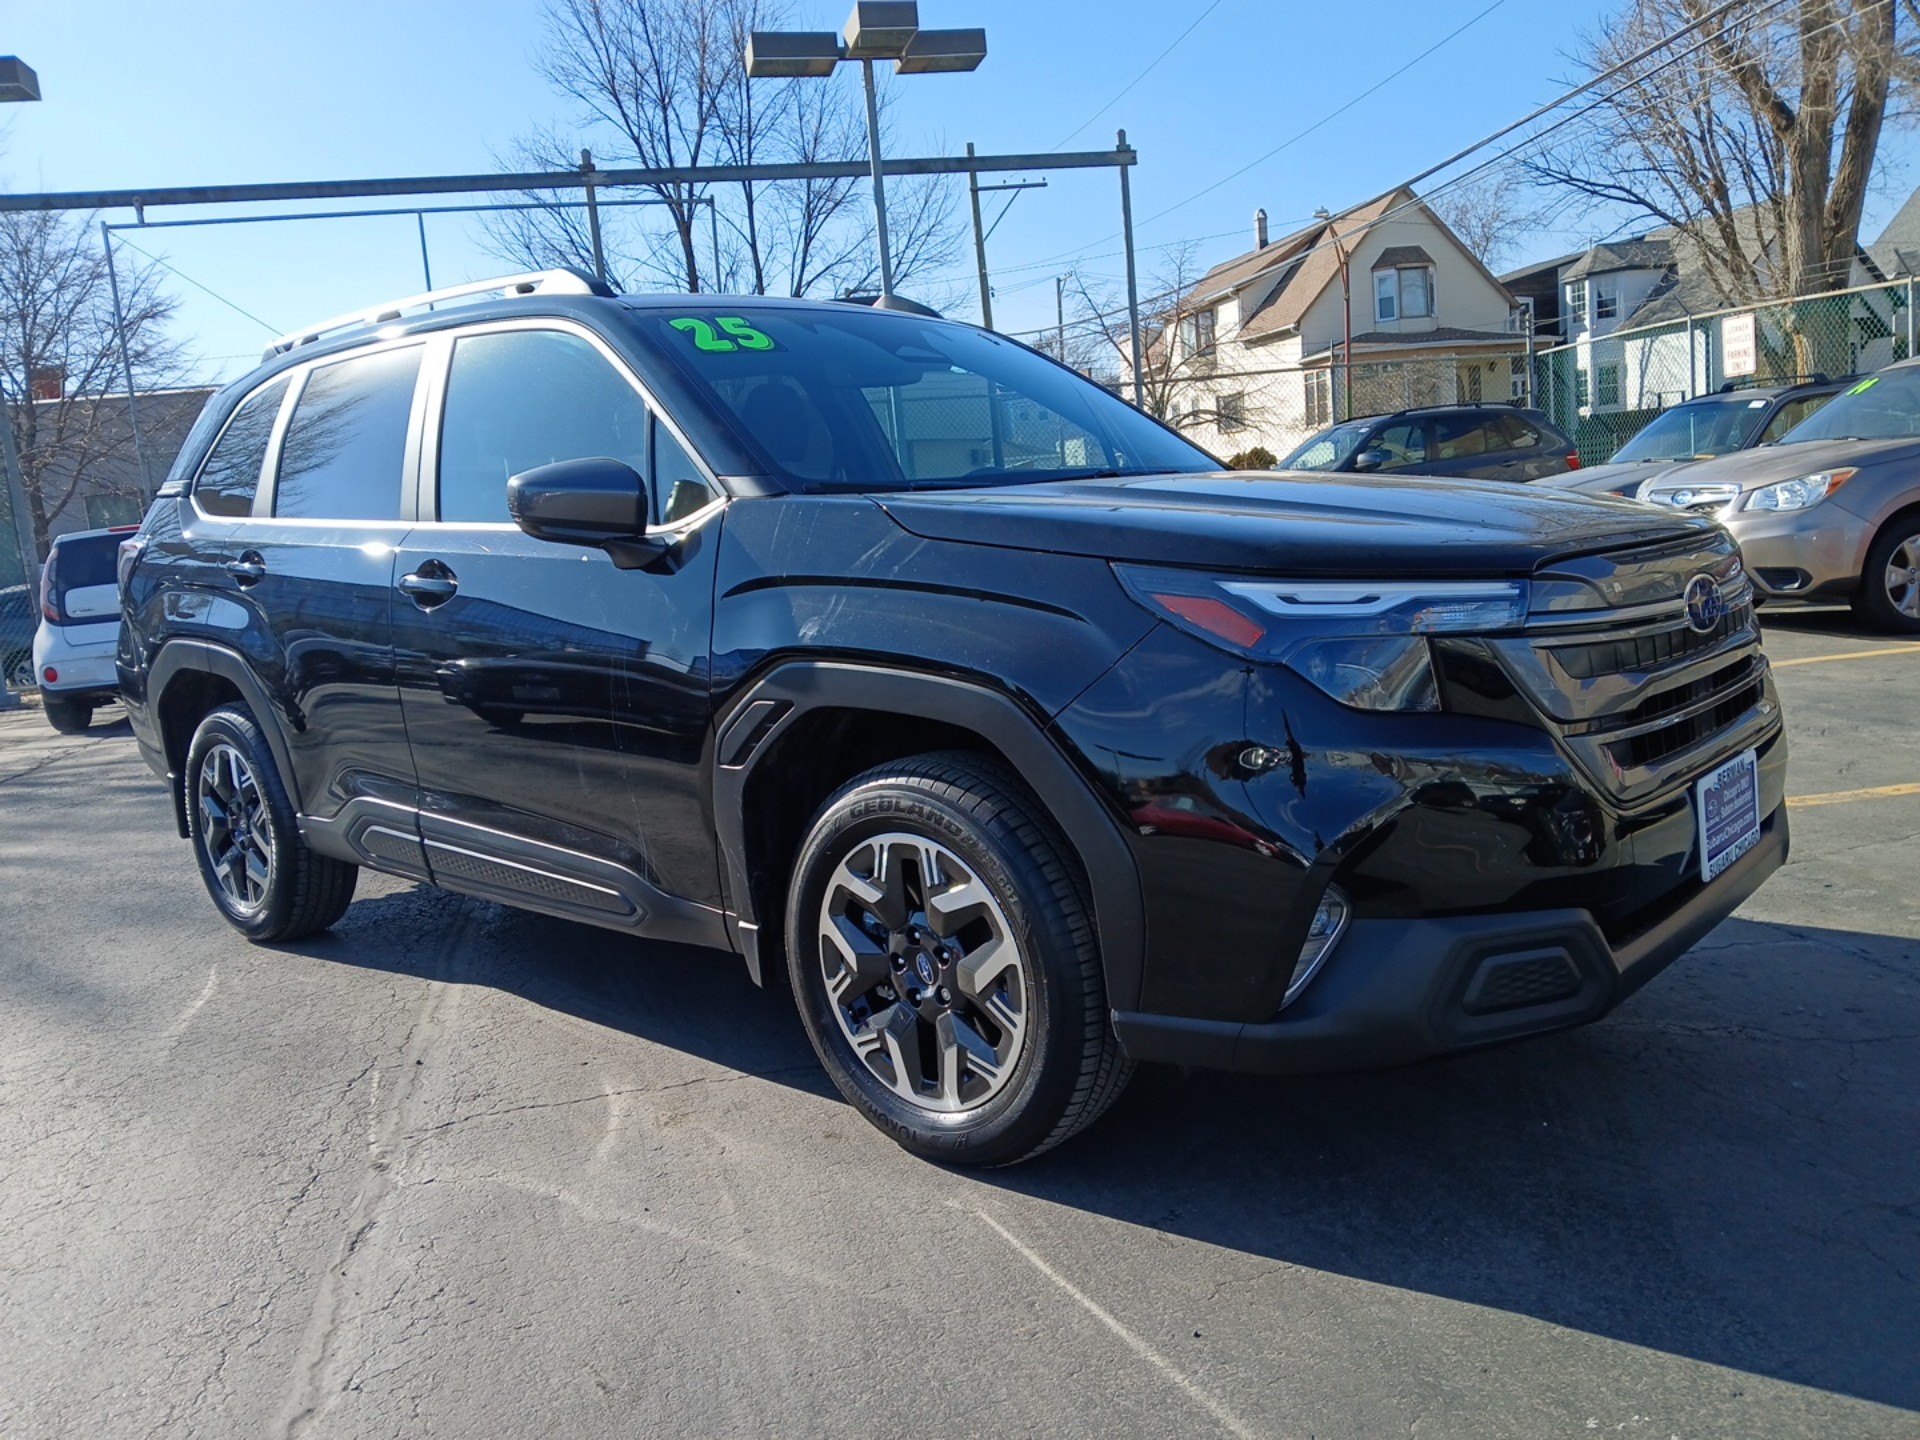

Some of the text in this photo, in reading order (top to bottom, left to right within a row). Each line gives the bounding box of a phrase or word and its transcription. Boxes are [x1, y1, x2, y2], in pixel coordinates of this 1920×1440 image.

[668, 315, 775, 352] 25
[1728, 323, 1749, 334] LOANER
[1726, 333, 1751, 344] VEHICLES
[1727, 347, 1751, 360] PARKING
[1732, 360, 1747, 372] ONLY
[1717, 757, 1745, 783] BERMAN
[1709, 828, 1760, 878] SUBARU CHICAGO
